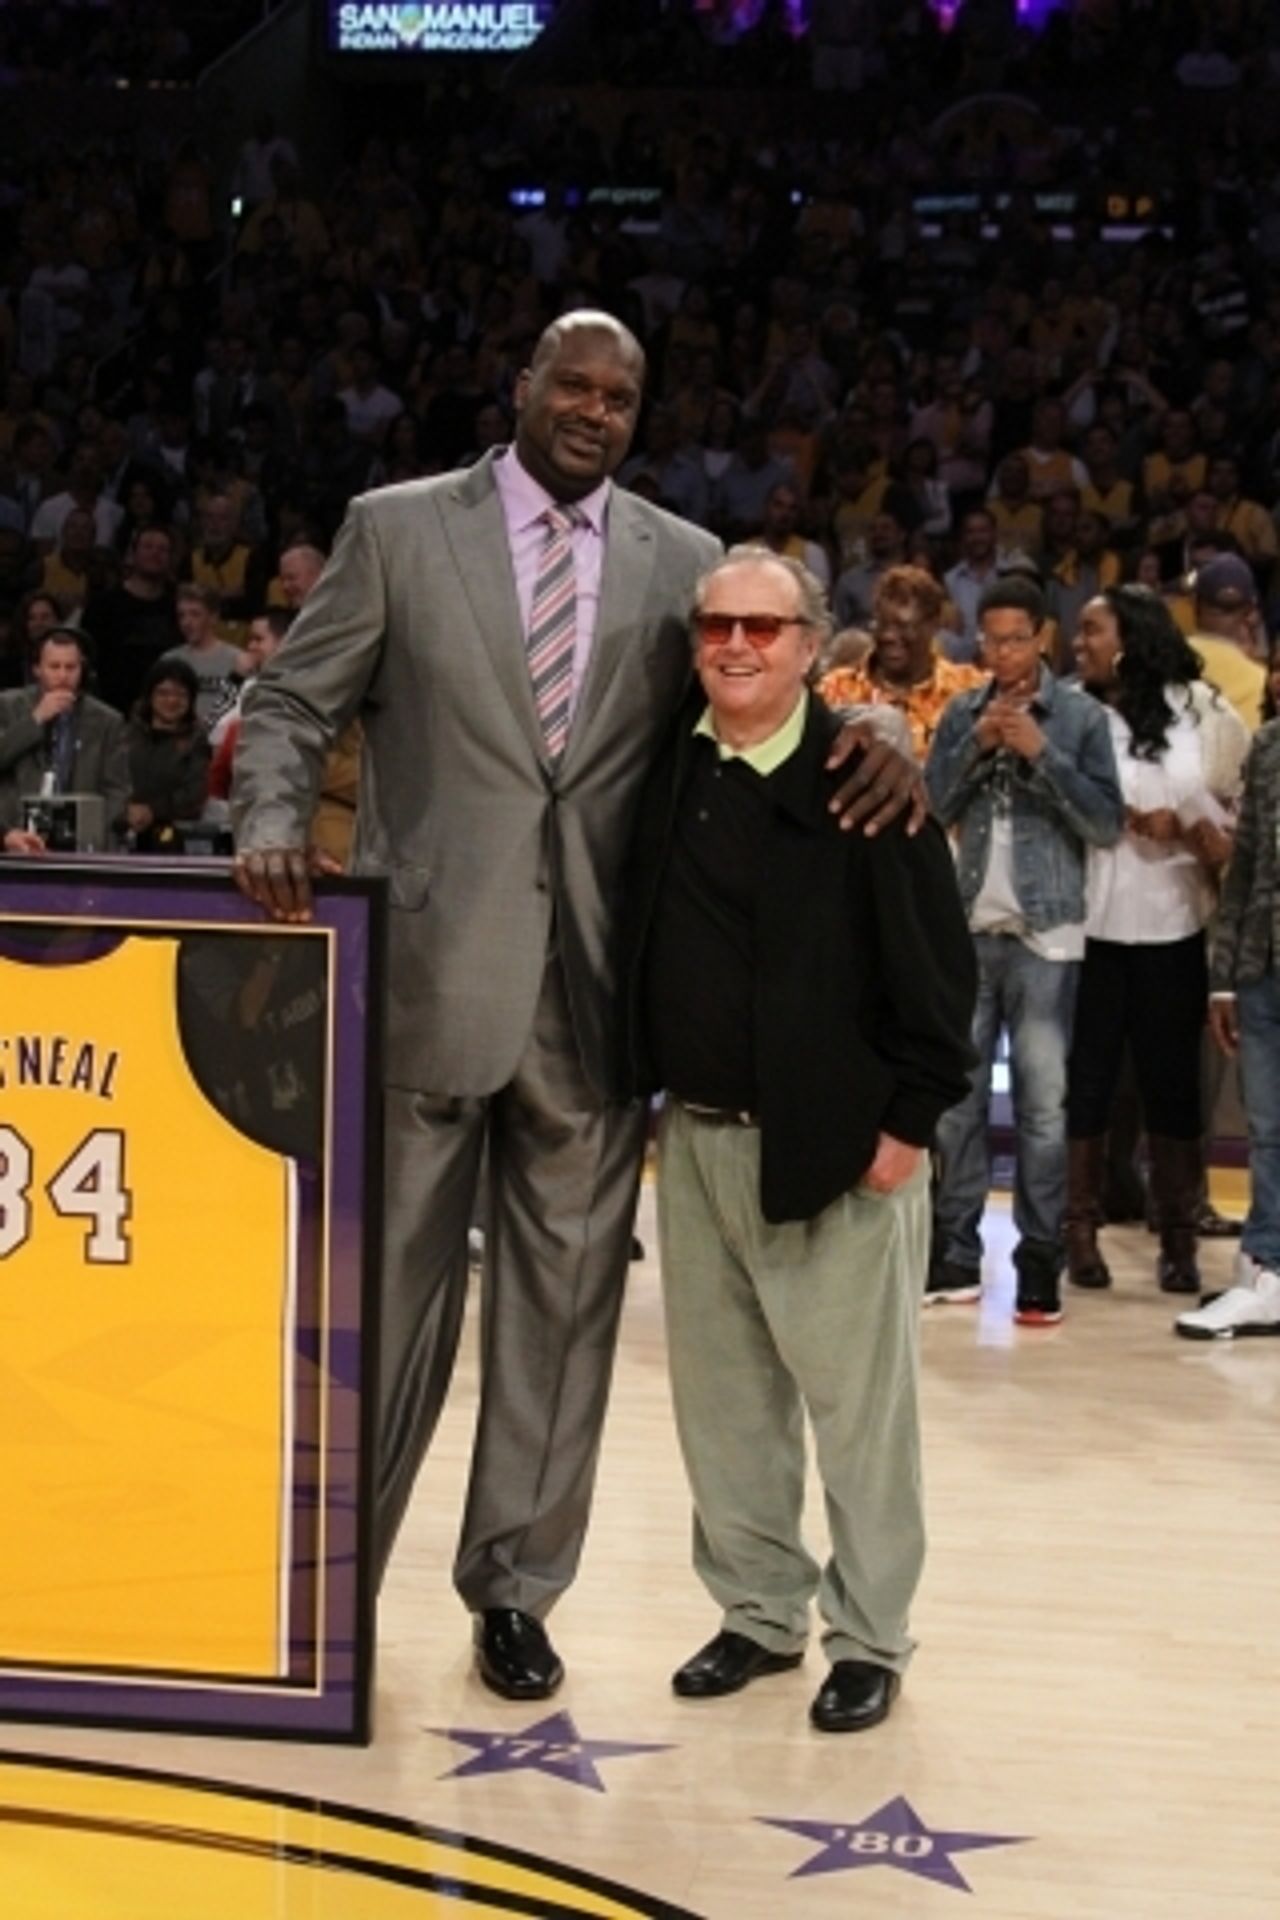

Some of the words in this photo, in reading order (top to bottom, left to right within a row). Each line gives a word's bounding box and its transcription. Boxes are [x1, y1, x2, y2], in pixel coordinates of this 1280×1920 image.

[340, 4, 399, 29] SAN
[424, 4, 544, 29] MANUEL
[0, 1036, 118, 1100] 'NEAL
[832, 1828, 934, 1857] '80
